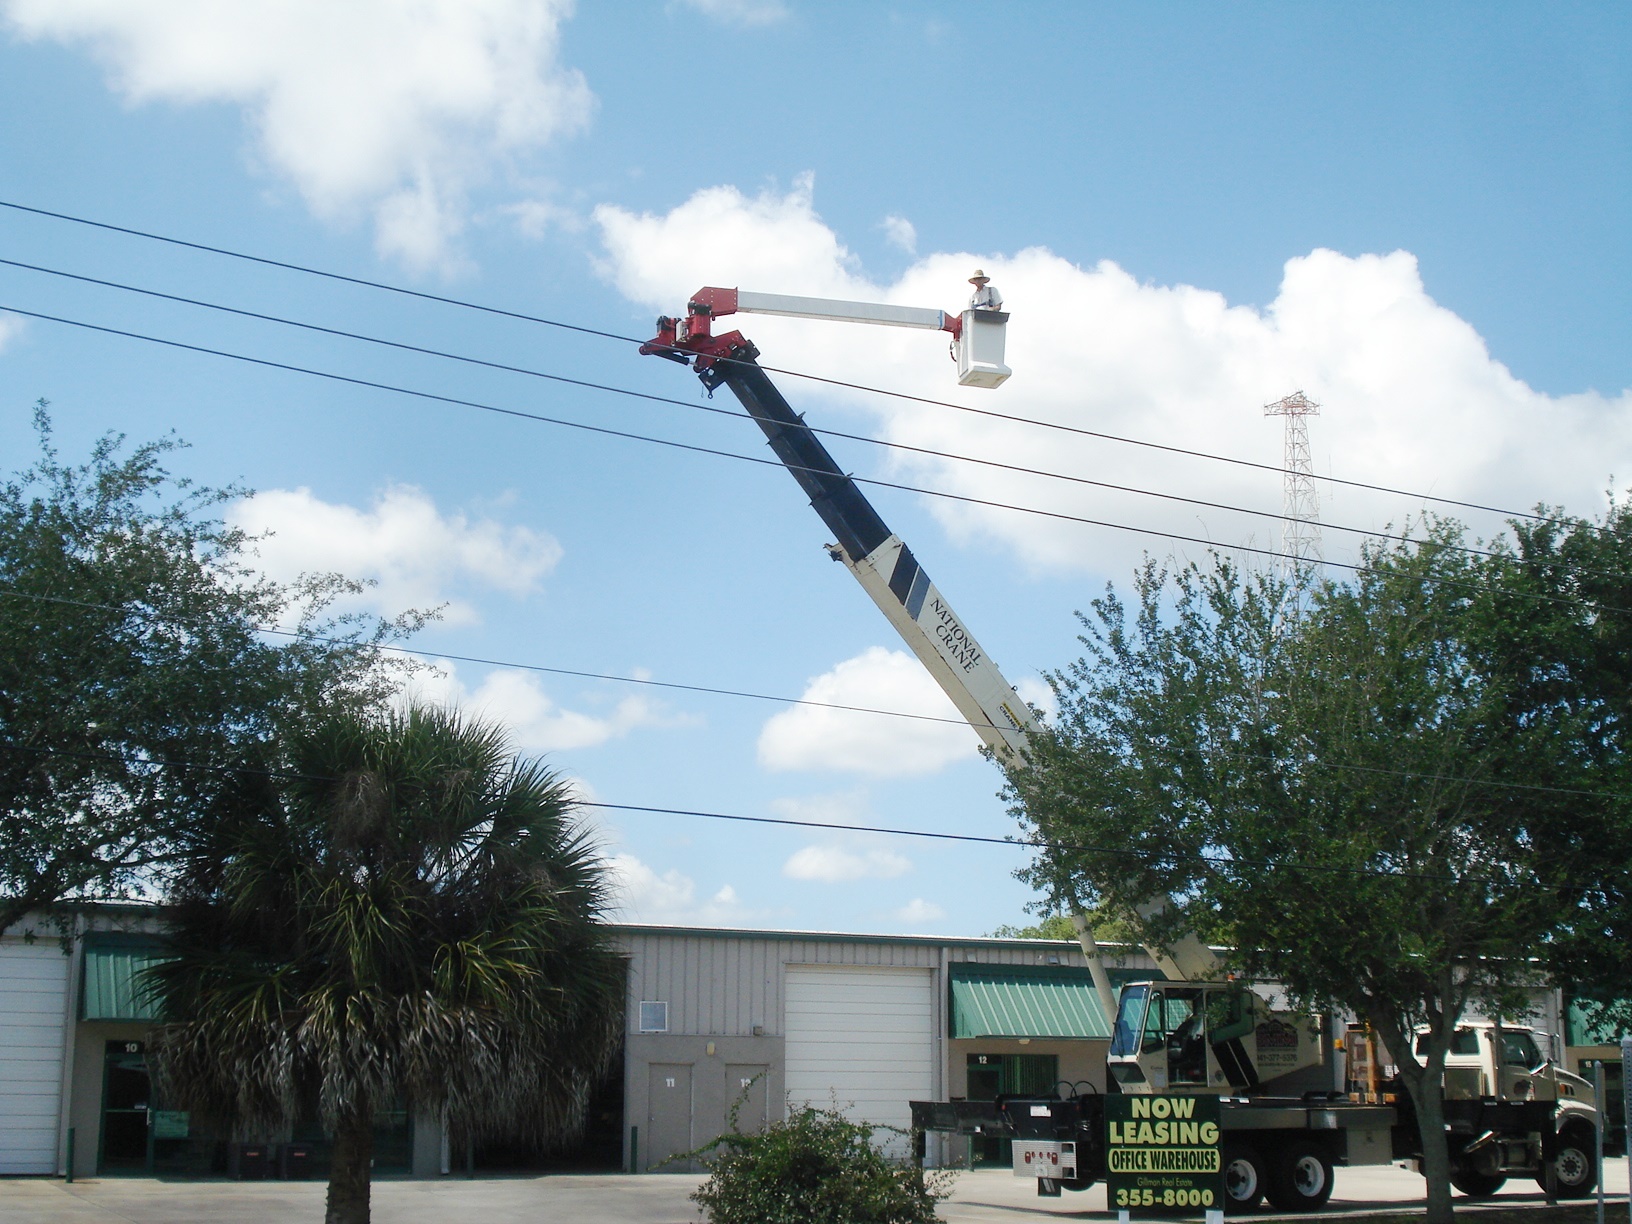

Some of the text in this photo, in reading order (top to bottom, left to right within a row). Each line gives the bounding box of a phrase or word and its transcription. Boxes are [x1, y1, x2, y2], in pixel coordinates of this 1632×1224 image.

[930, 597, 981, 667] NATIONAL
[935, 624, 975, 674] CRANE
[125, 1043, 138, 1053] 10
[978, 1055, 988, 1064] 12
[665, 1078, 675, 1088] 11
[1131, 1097, 1196, 1119] NOW
[1109, 1121, 1220, 1145] LEASING
[1111, 1150, 1217, 1171] OFFICE WAREHOUSE
[1161, 1177, 1175, 1187] Real
[1176, 1178, 1193, 1187] Estate
[1116, 1189, 1214, 1207] 355-8000
